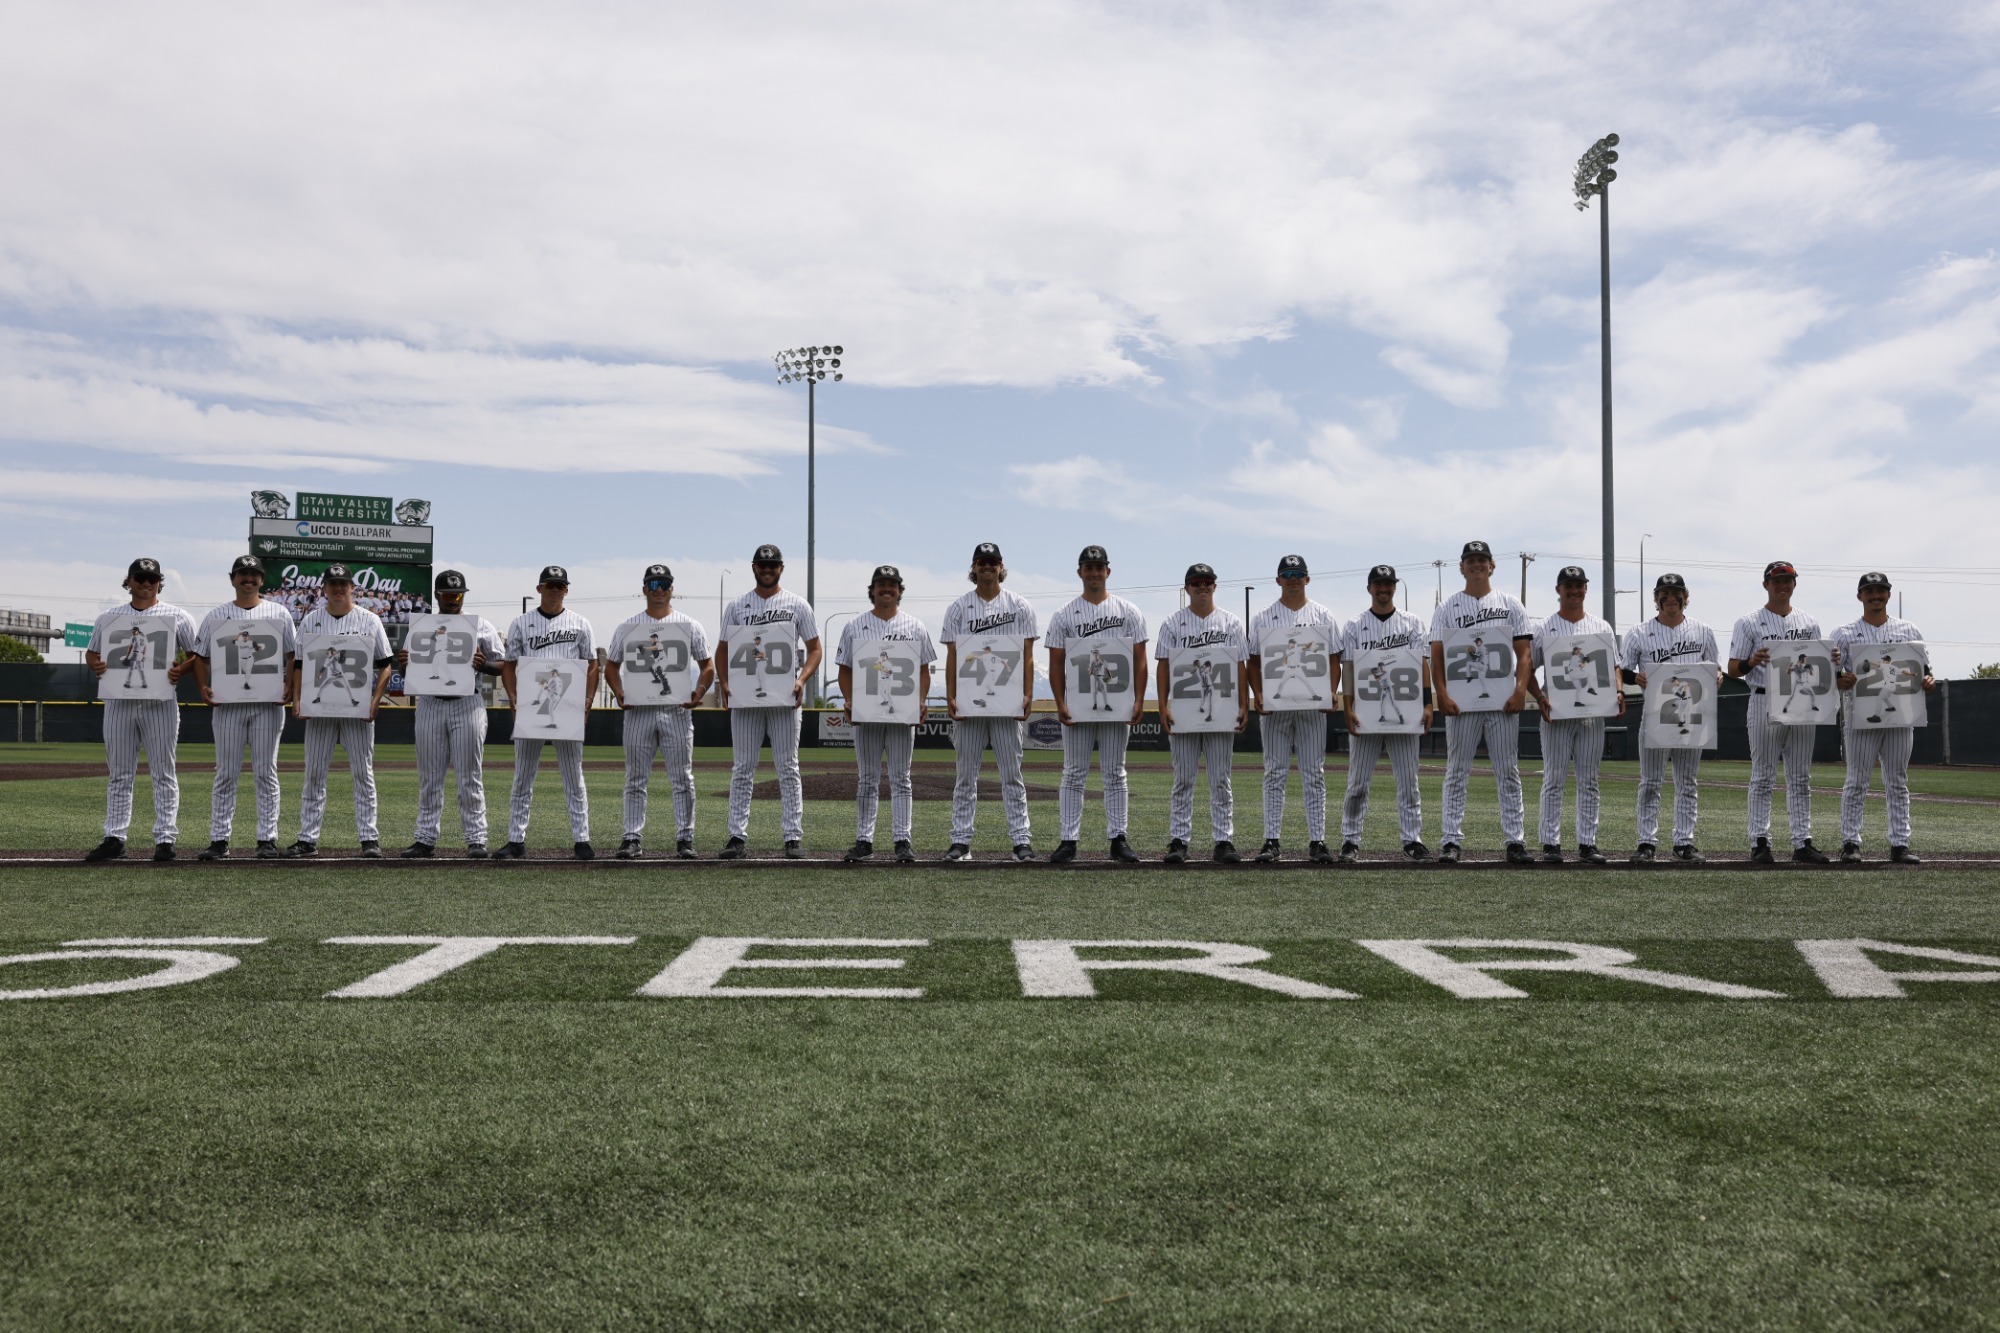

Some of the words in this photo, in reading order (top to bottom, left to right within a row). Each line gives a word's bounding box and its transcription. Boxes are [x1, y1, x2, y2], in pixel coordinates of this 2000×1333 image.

[302, 496, 334, 507] UTAH
[340, 498, 388, 509] VALLEY
[302, 507, 388, 520] UNIVERSITY
[280, 540, 344, 551] Intermountain
[310, 526, 340, 537] UCCU
[342, 528, 392, 538] BALLPARK
[280, 549, 323, 558] Healthcare
[281, 564, 325, 589] Seni
[352, 567, 402, 592] Day
[766, 610, 794, 622] Valley
[967, 618, 990, 633] Utah
[988, 613, 1016, 626] Valley
[1075, 622, 1098, 637] Utah
[1096, 616, 1124, 631] Valley
[1480, 608, 1510, 621] Valley
[106, 630, 168, 669] 21
[216, 635, 278, 676] 12
[410, 631, 474, 664] 99
[527, 634, 552, 650] Utah
[549, 630, 577, 644] Valley
[625, 640, 688, 673] 30
[1673, 641, 1702, 654] Valley
[730, 642, 792, 675] 40
[959, 651, 1020, 686] 47
[1070, 654, 1130, 693] 19
[1264, 643, 1328, 680] 25
[1447, 643, 1512, 680] 20
[1550, 649, 1610, 690] 31
[858, 657, 916, 696] 13
[1172, 662, 1235, 699] 24
[1357, 668, 1420, 701] 38
[1770, 656, 1831, 696] 10
[1855, 660, 1922, 697] 29
[535, 671, 572, 715] 7
[1660, 678, 1703, 724] 2
[1132, 724, 1161, 735] UCCU
